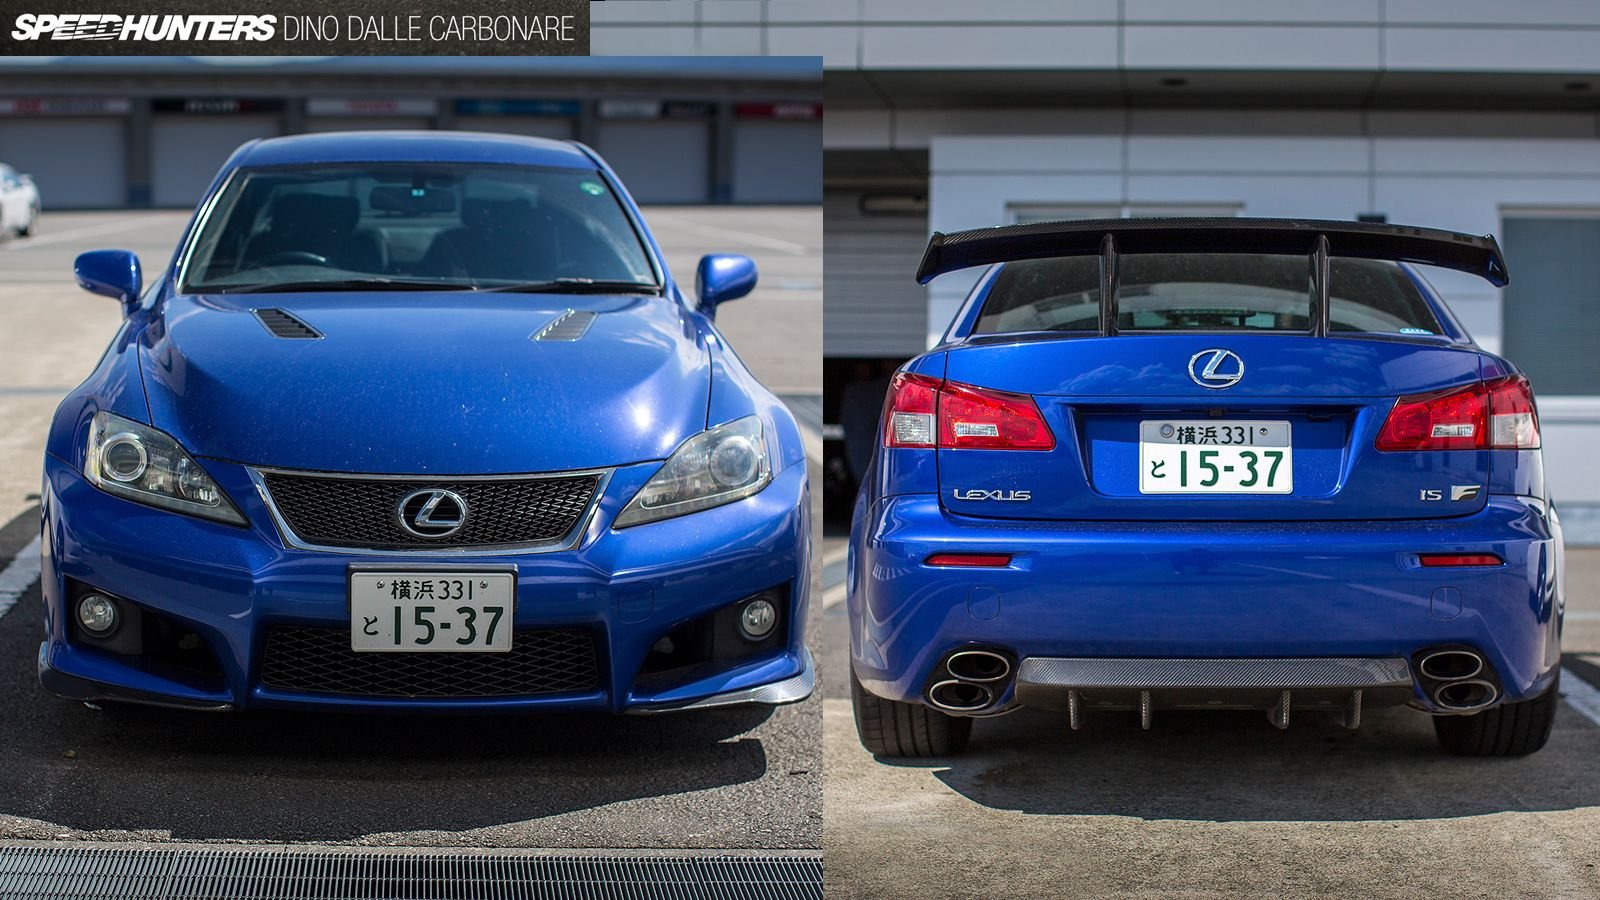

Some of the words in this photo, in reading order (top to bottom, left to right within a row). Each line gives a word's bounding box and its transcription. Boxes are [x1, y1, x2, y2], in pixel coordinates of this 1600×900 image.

[1180, 450, 1284, 487] 15-37
[953, 488, 1031, 501] LEXUS
[1420, 489, 1443, 501] IS
[394, 605, 504, 646] 15-37
